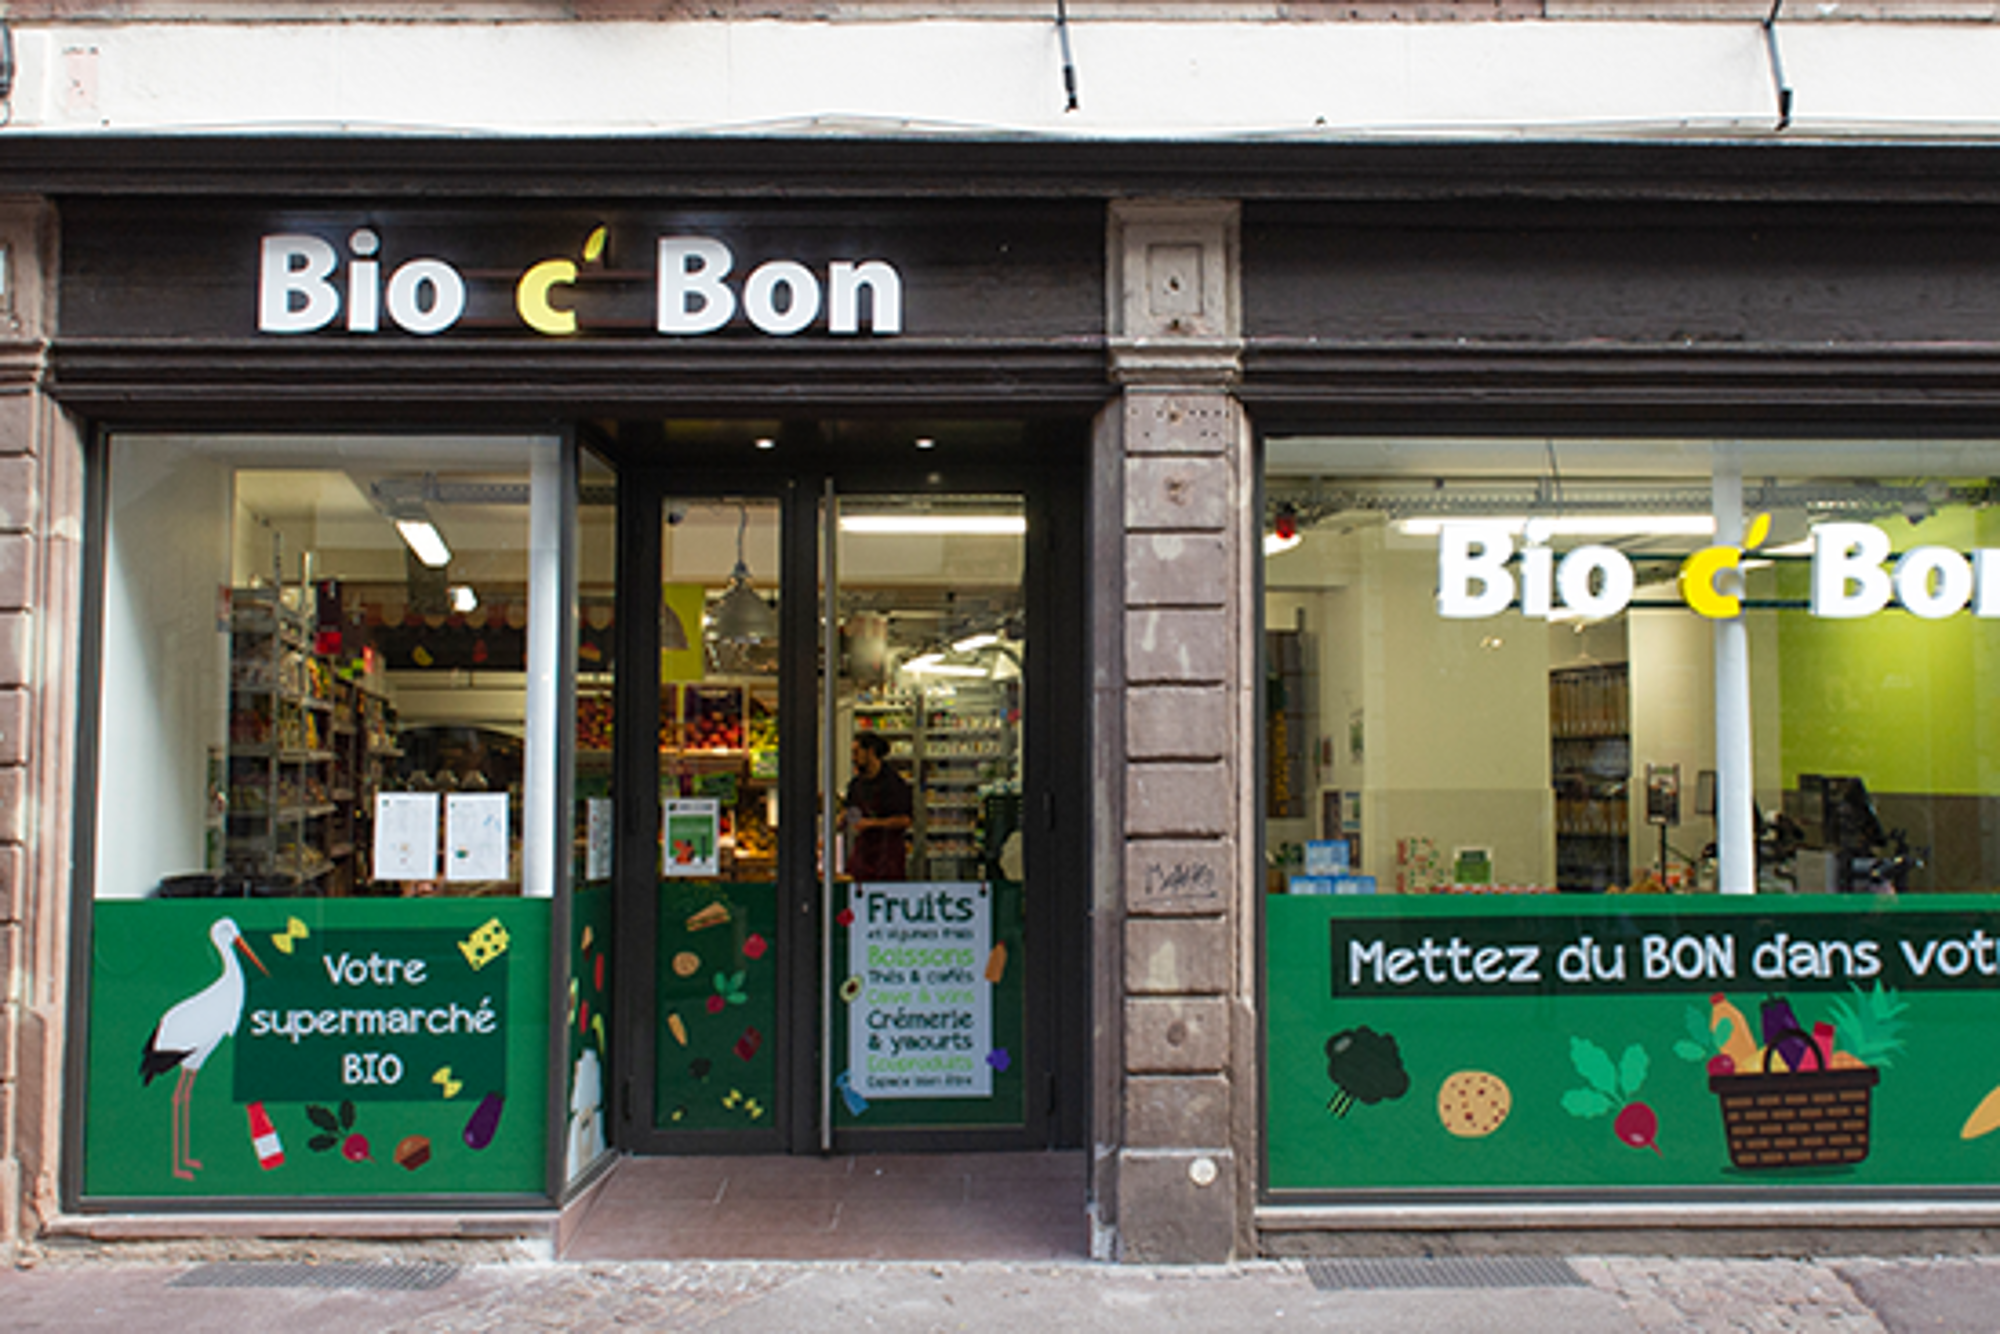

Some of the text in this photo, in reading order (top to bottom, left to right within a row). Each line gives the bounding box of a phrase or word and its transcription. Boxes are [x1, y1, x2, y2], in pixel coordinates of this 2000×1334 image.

[258, 229, 465, 335] Bio
[655, 236, 903, 335] Bon
[1438, 519, 1635, 620] Bio
[867, 891, 975, 923] Fruits
[323, 953, 427, 986] Votre
[867, 944, 975, 967] Boissons
[1350, 929, 2000, 984] Mettez du BON dans vot
[910, 969, 921, 984] &
[249, 997, 496, 1043] supermarché
[867, 1006, 975, 1030] Crémerie
[867, 1032, 974, 1057] & yaourts
[343, 1053, 404, 1085] BIO
